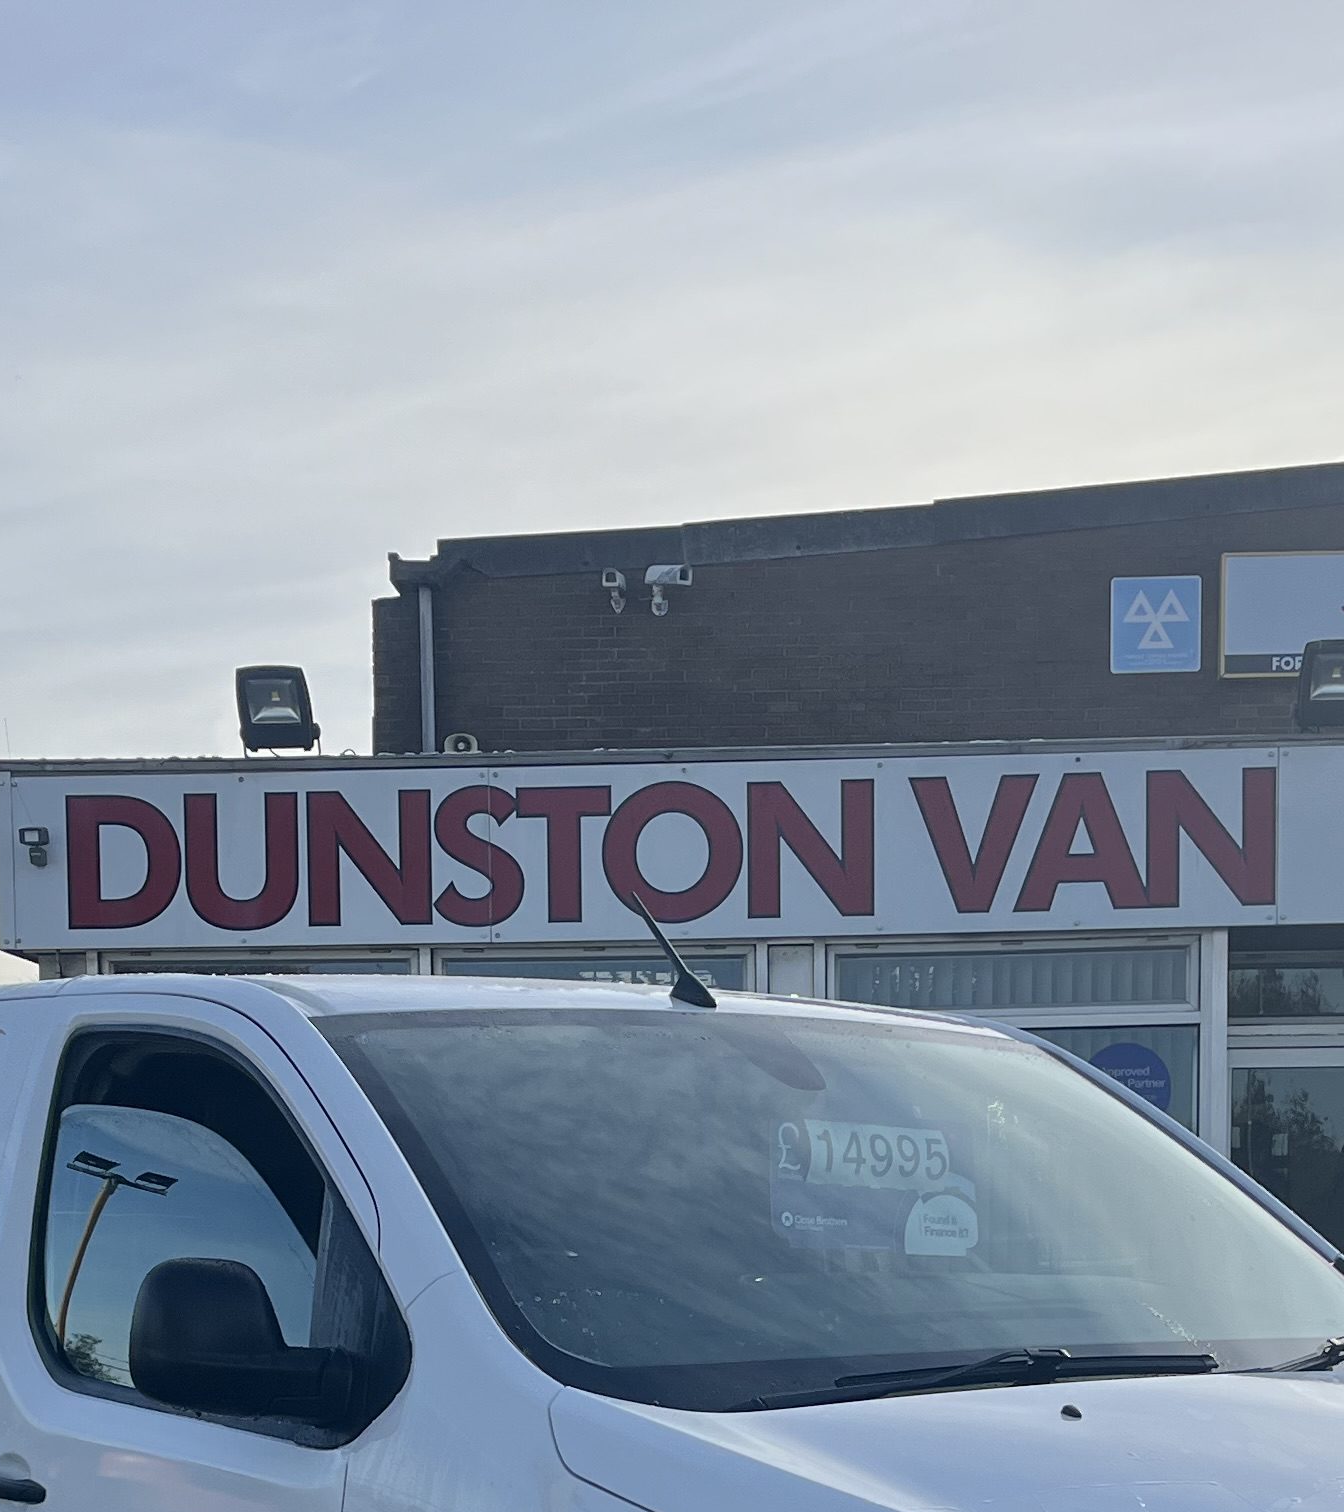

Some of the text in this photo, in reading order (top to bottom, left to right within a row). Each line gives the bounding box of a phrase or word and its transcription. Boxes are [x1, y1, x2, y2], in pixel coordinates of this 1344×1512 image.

[65, 778, 875, 931] DUNSTON
[907, 766, 1278, 915] VAN
[1102, 1065, 1151, 1078] pproved
[1127, 1079, 1166, 1089] Partner
